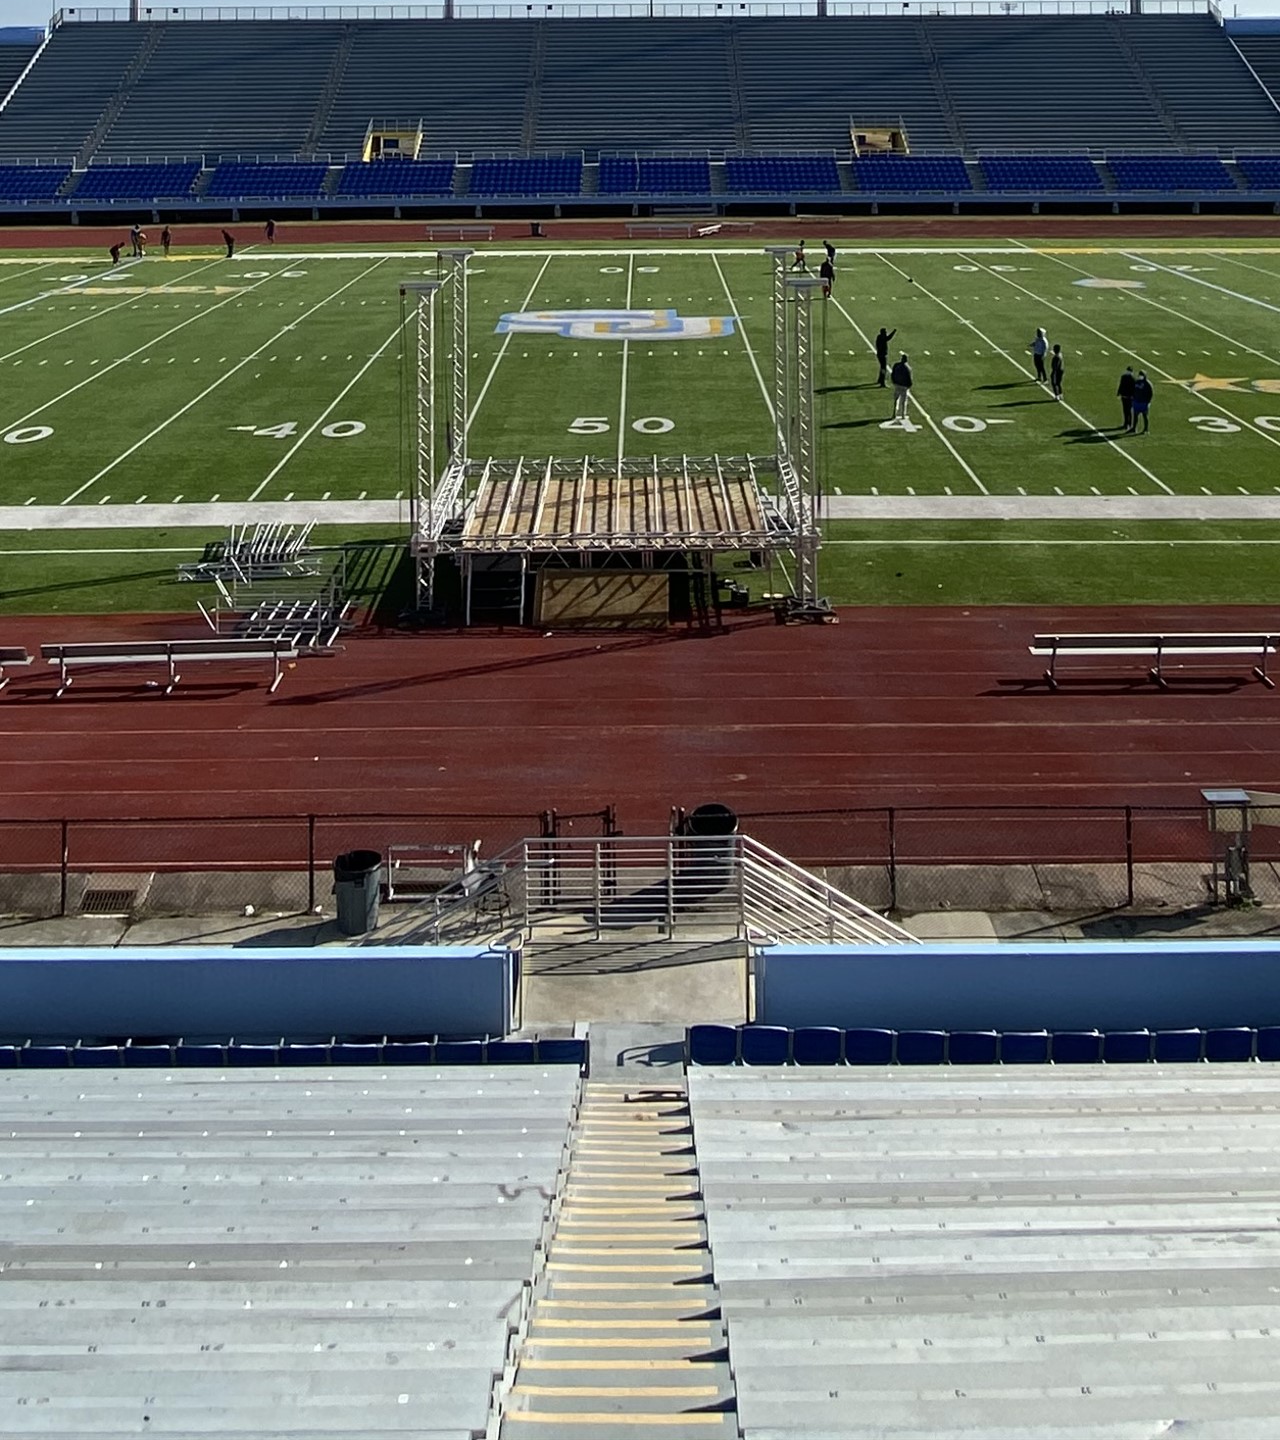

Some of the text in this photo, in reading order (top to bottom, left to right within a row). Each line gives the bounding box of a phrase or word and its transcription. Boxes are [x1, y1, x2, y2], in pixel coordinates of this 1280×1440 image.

[252, 420, 367, 439] 40
[566, 416, 676, 434] 50
[878, 415, 987, 433] 40
